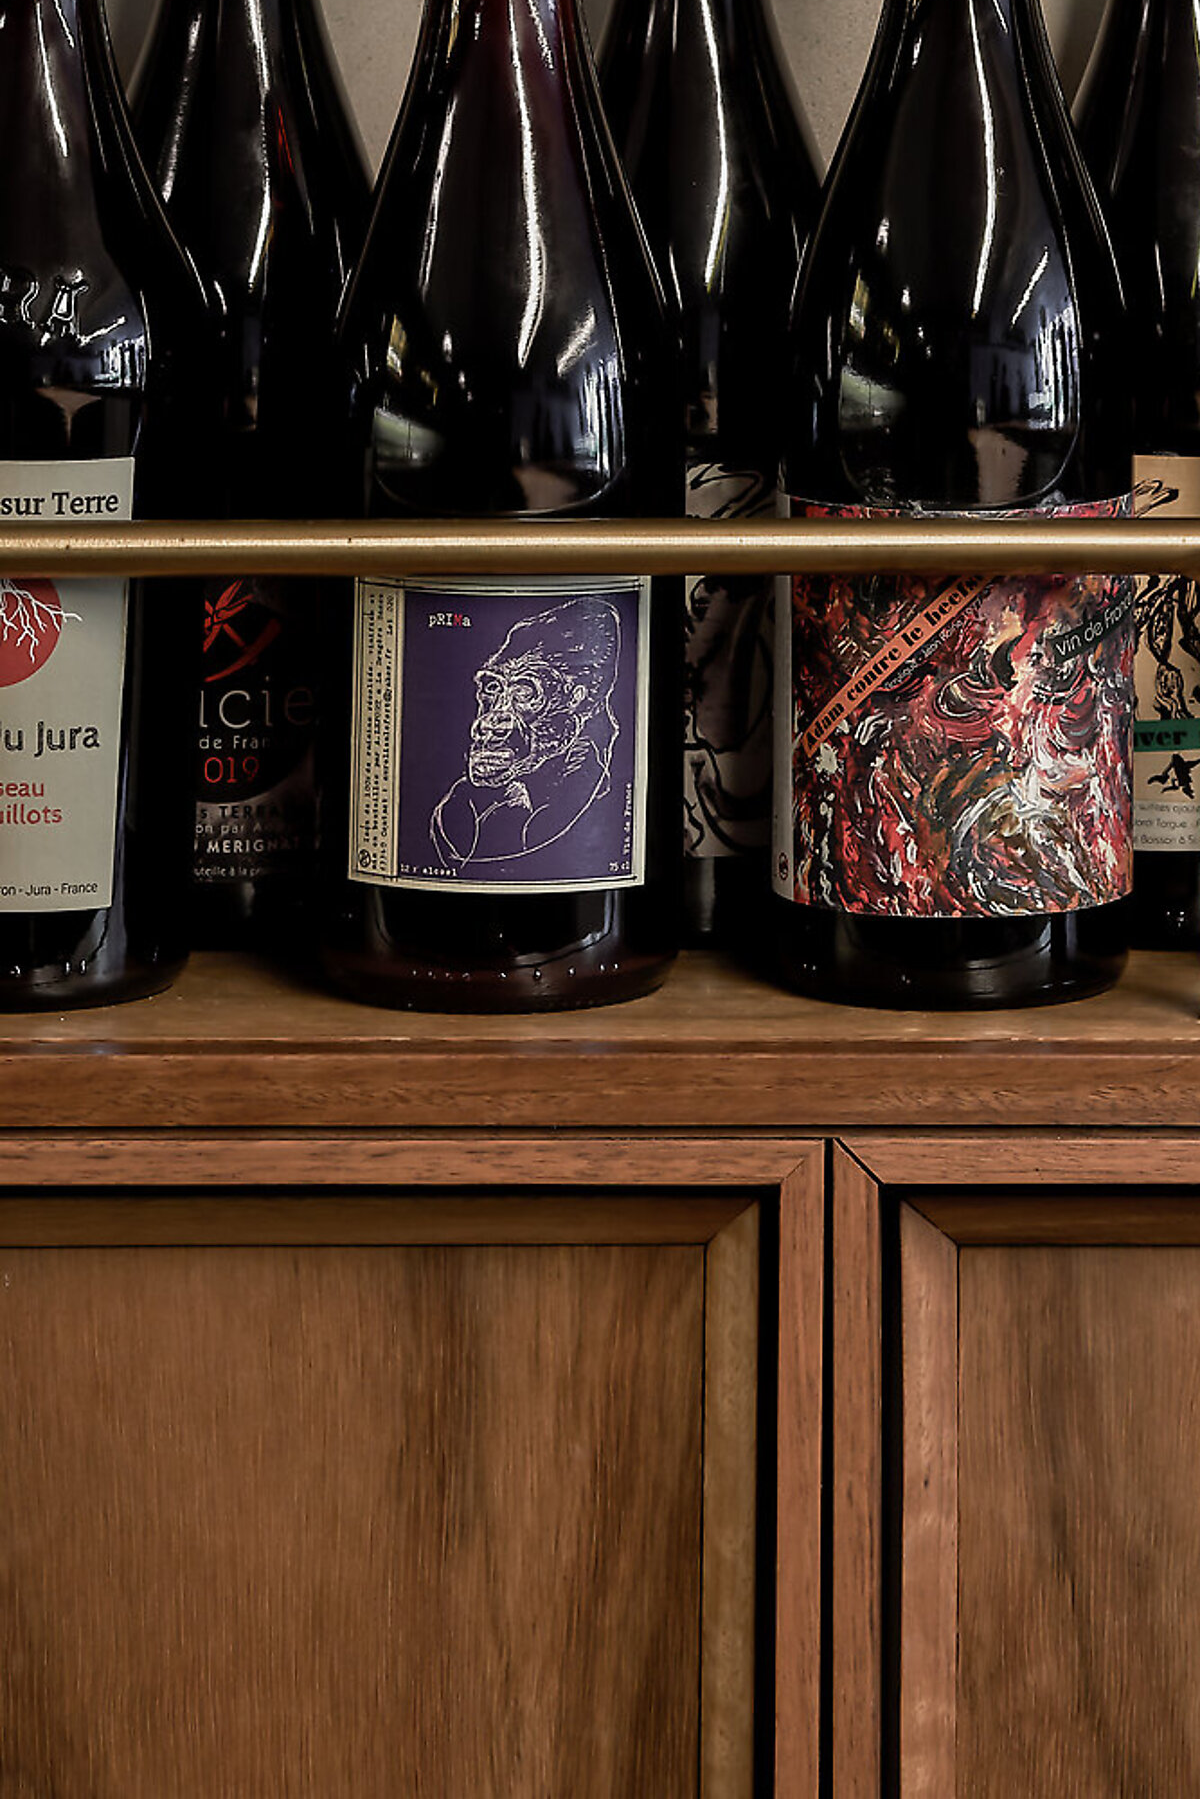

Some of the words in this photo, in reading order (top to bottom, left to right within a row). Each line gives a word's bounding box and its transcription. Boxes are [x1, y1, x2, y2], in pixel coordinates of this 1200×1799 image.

[1, 497, 45, 515] sur
[52, 491, 119, 515] Terre
[1055, 635, 1082, 656] vin
[1084, 621, 1103, 641] de
[807, 703, 845, 747] Adam
[846, 647, 902, 701] contre
[901, 627, 924, 647] le
[199, 735, 223, 750] de
[25, 884, 51, 897] Jura
[61, 882, 98, 896] France
